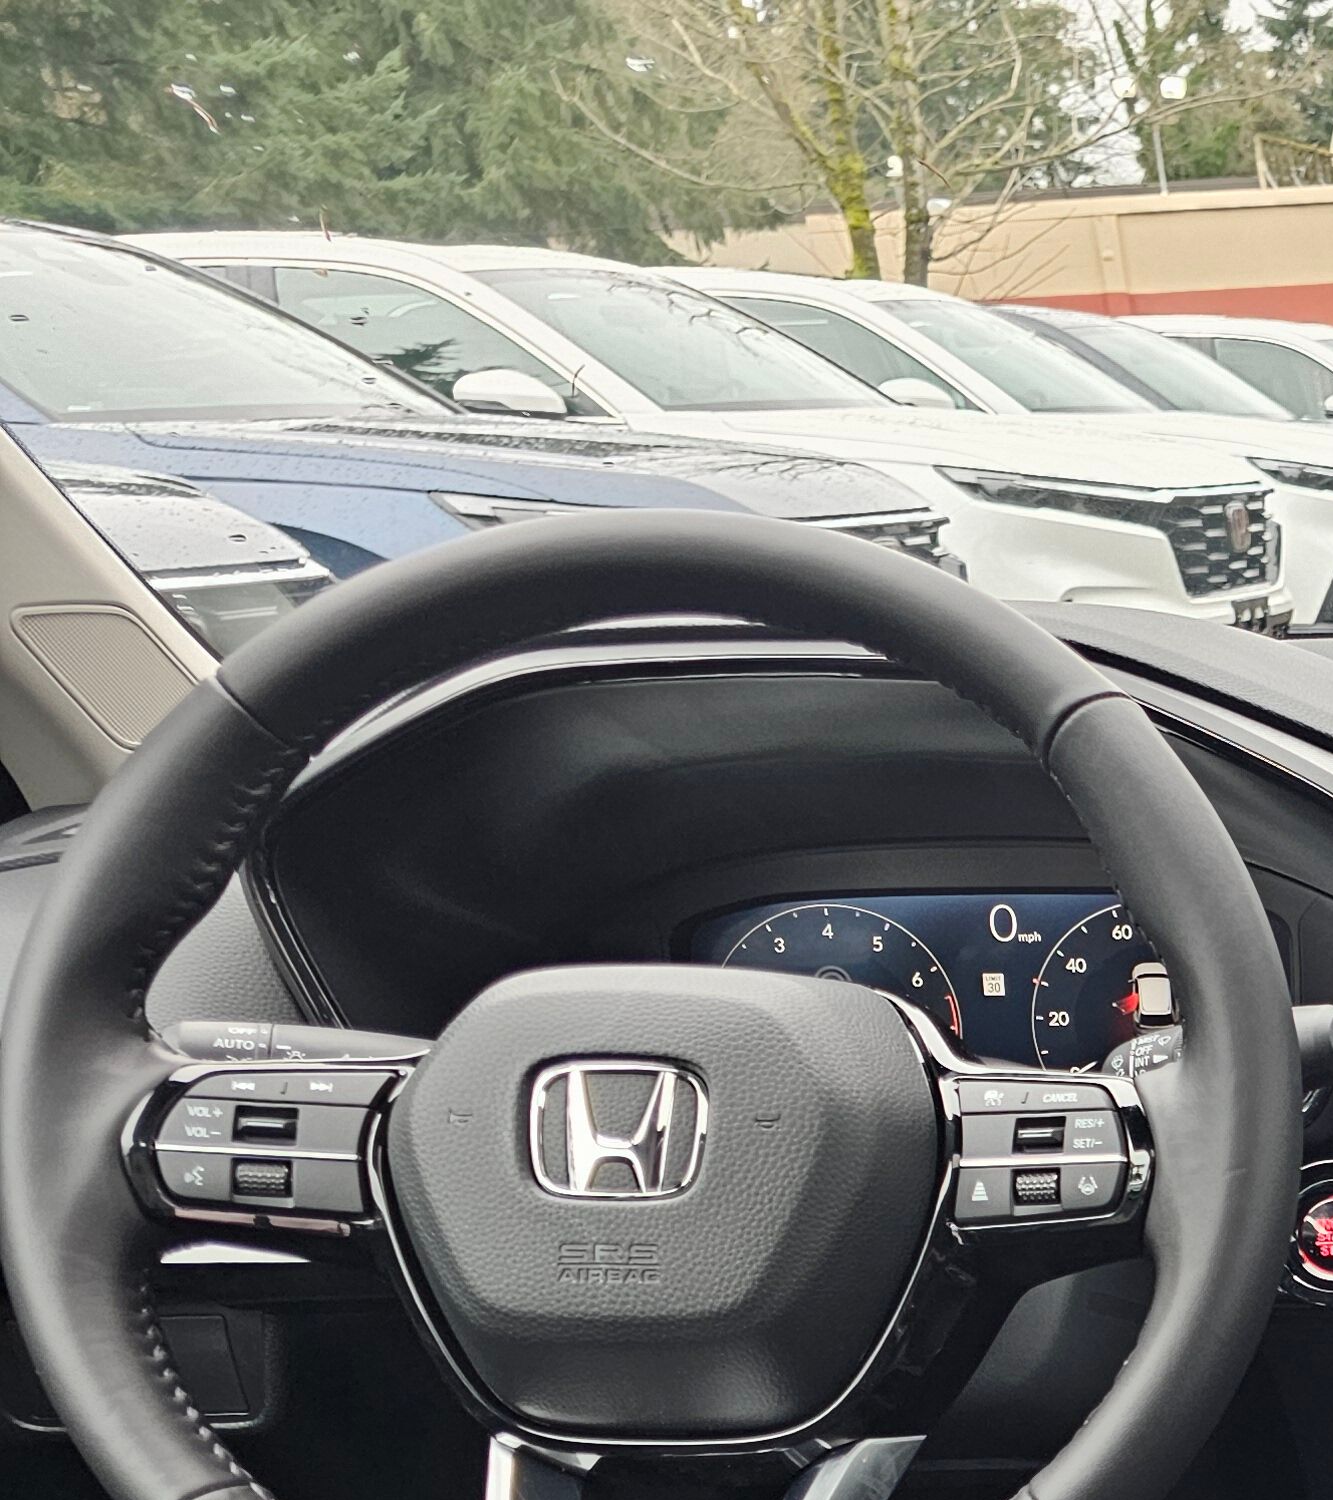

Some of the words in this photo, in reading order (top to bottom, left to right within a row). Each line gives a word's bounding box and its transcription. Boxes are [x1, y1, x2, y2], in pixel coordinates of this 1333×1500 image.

[990, 904, 1017, 942] 0
[1018, 931, 1041, 944] mph
[821, 924, 834, 940] 4
[1112, 925, 1132, 941] 60
[774, 938, 785, 953] 3
[873, 936, 884, 952] 5
[1066, 958, 1086, 973] 40
[911, 973, 923, 988] 6
[988, 983, 1001, 993] 30
[1049, 1012, 1069, 1027] 20
[213, 1038, 255, 1050] AUTO
[1135, 1045, 1153, 1056] OFF
[1135, 1055, 1150, 1068] INT
[1043, 1092, 1078, 1103] CANCEL
[558, 1242, 659, 1264] SRS
[557, 1267, 660, 1284] AIRBAG
